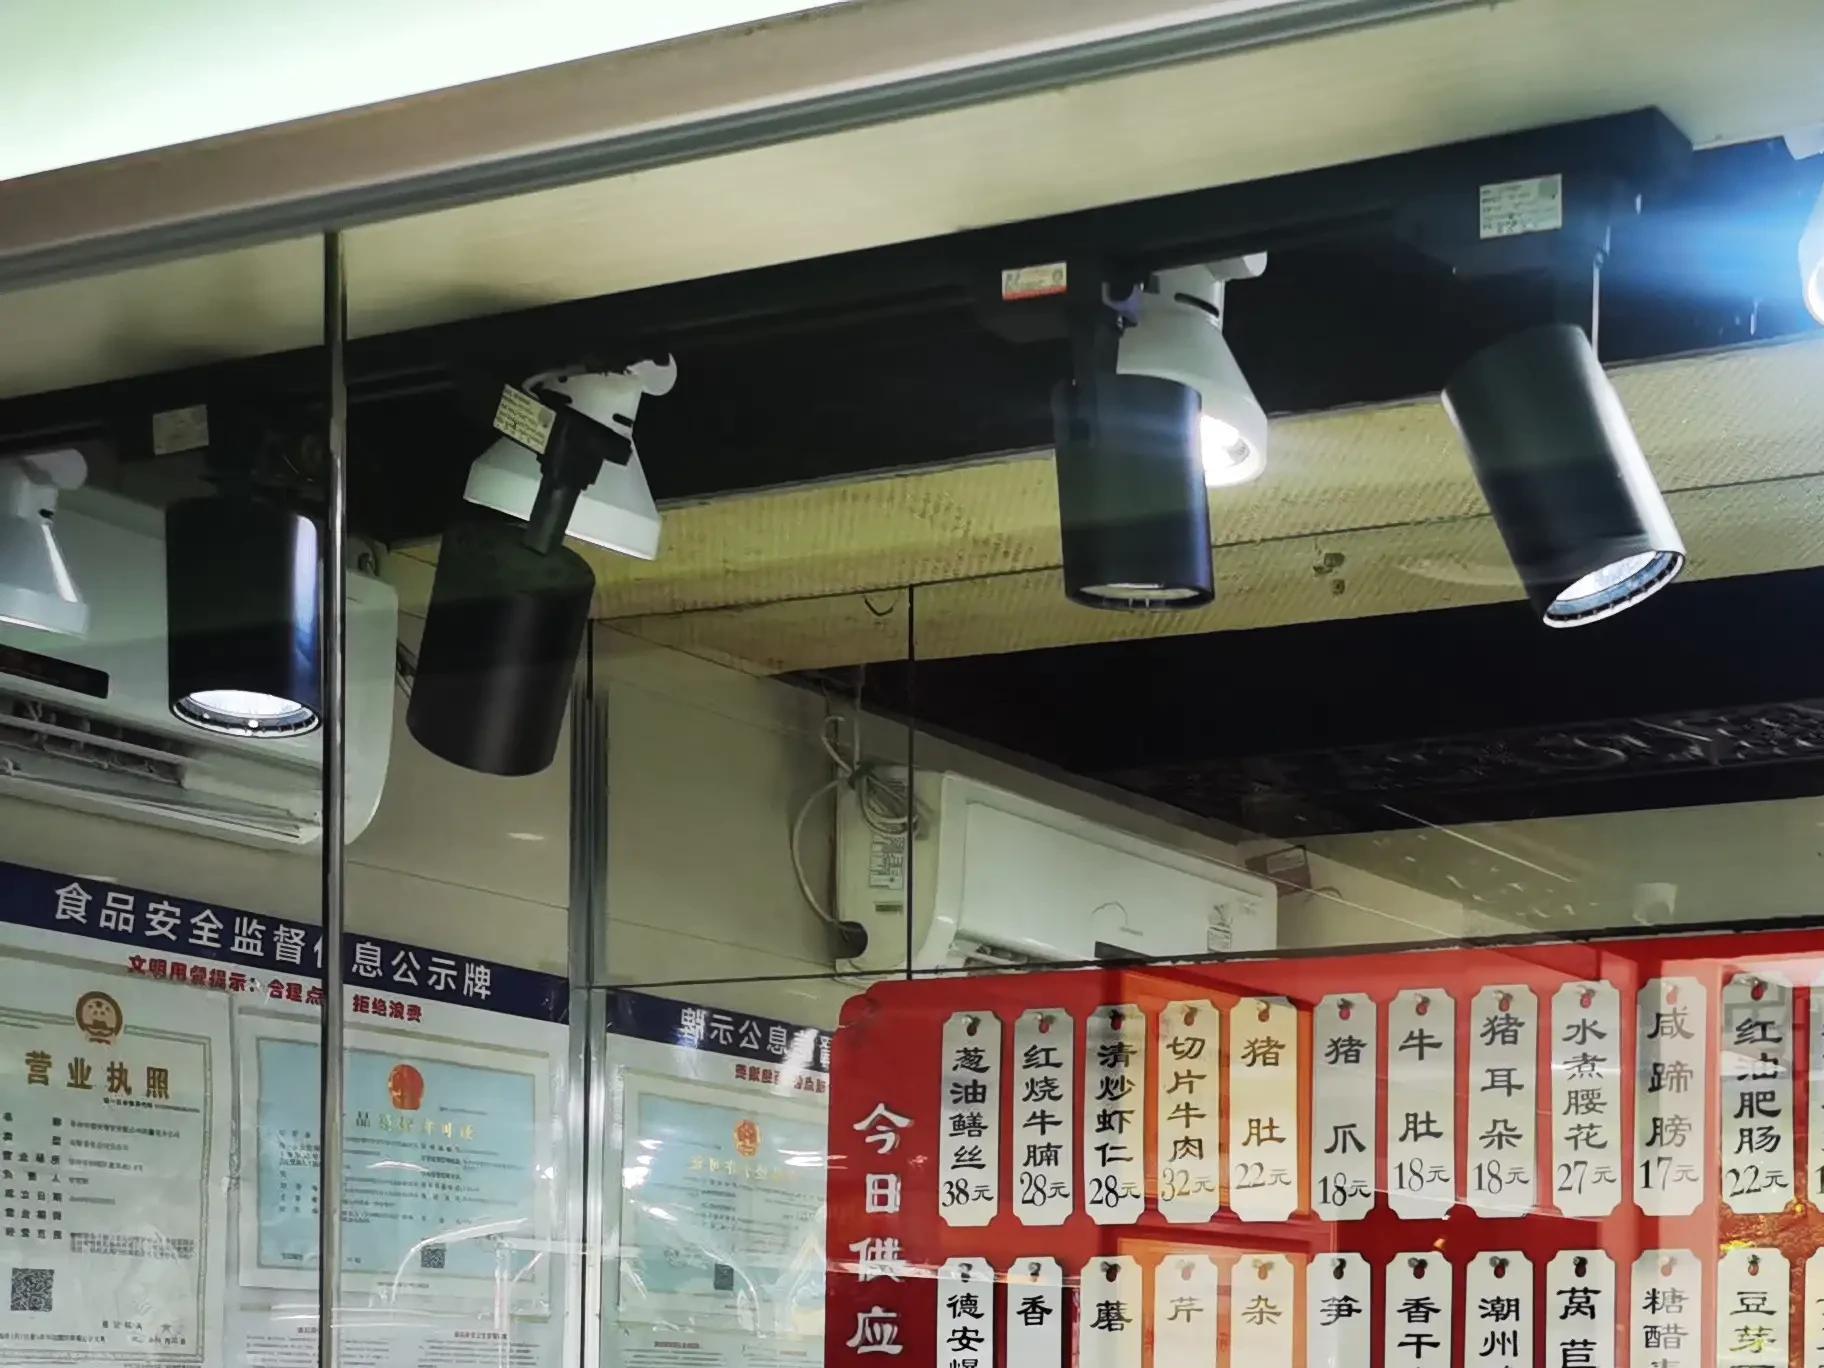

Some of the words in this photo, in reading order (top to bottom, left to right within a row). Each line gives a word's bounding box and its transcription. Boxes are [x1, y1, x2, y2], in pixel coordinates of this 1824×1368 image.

[55, 882, 492, 1000] 食品安全监督息公示牌
[25, 1051, 170, 1099] 营业执照
[949, 1046, 991, 1171] 葱油鳝丝
[1022, 1044, 1064, 1168] 红烧牛腩
[1095, 1041, 1137, 1166] 清炒虾仁
[1166, 1036, 1207, 1162] 切片牛肉
[1240, 1036, 1287, 1148] 猪肚
[1324, 1034, 1368, 1156] 猪爪
[1398, 1028, 1443, 1143] 牛肚
[1478, 1013, 1526, 1150] 猪耳朵
[1561, 1017, 1608, 1151] 水煮腰花
[1646, 1007, 1695, 1149] 咸蹄膀
[941, 1177, 994, 1208] 38元
[1019, 1172, 1071, 1207] 28元
[1089, 1176, 1141, 1208] 28元
[1161, 1169, 1215, 1203] 32元
[1235, 1162, 1292, 1191] 22元
[1318, 1175, 1371, 1206] 18元
[1394, 1156, 1451, 1193] 18元
[1472, 1159, 1530, 1195] 18元
[1556, 1160, 1618, 1196] 27元
[1640, 1156, 1700, 1192] 17元
[1725, 1164, 1790, 1197] 22元
[846, 1102, 915, 1356] 今日供应
